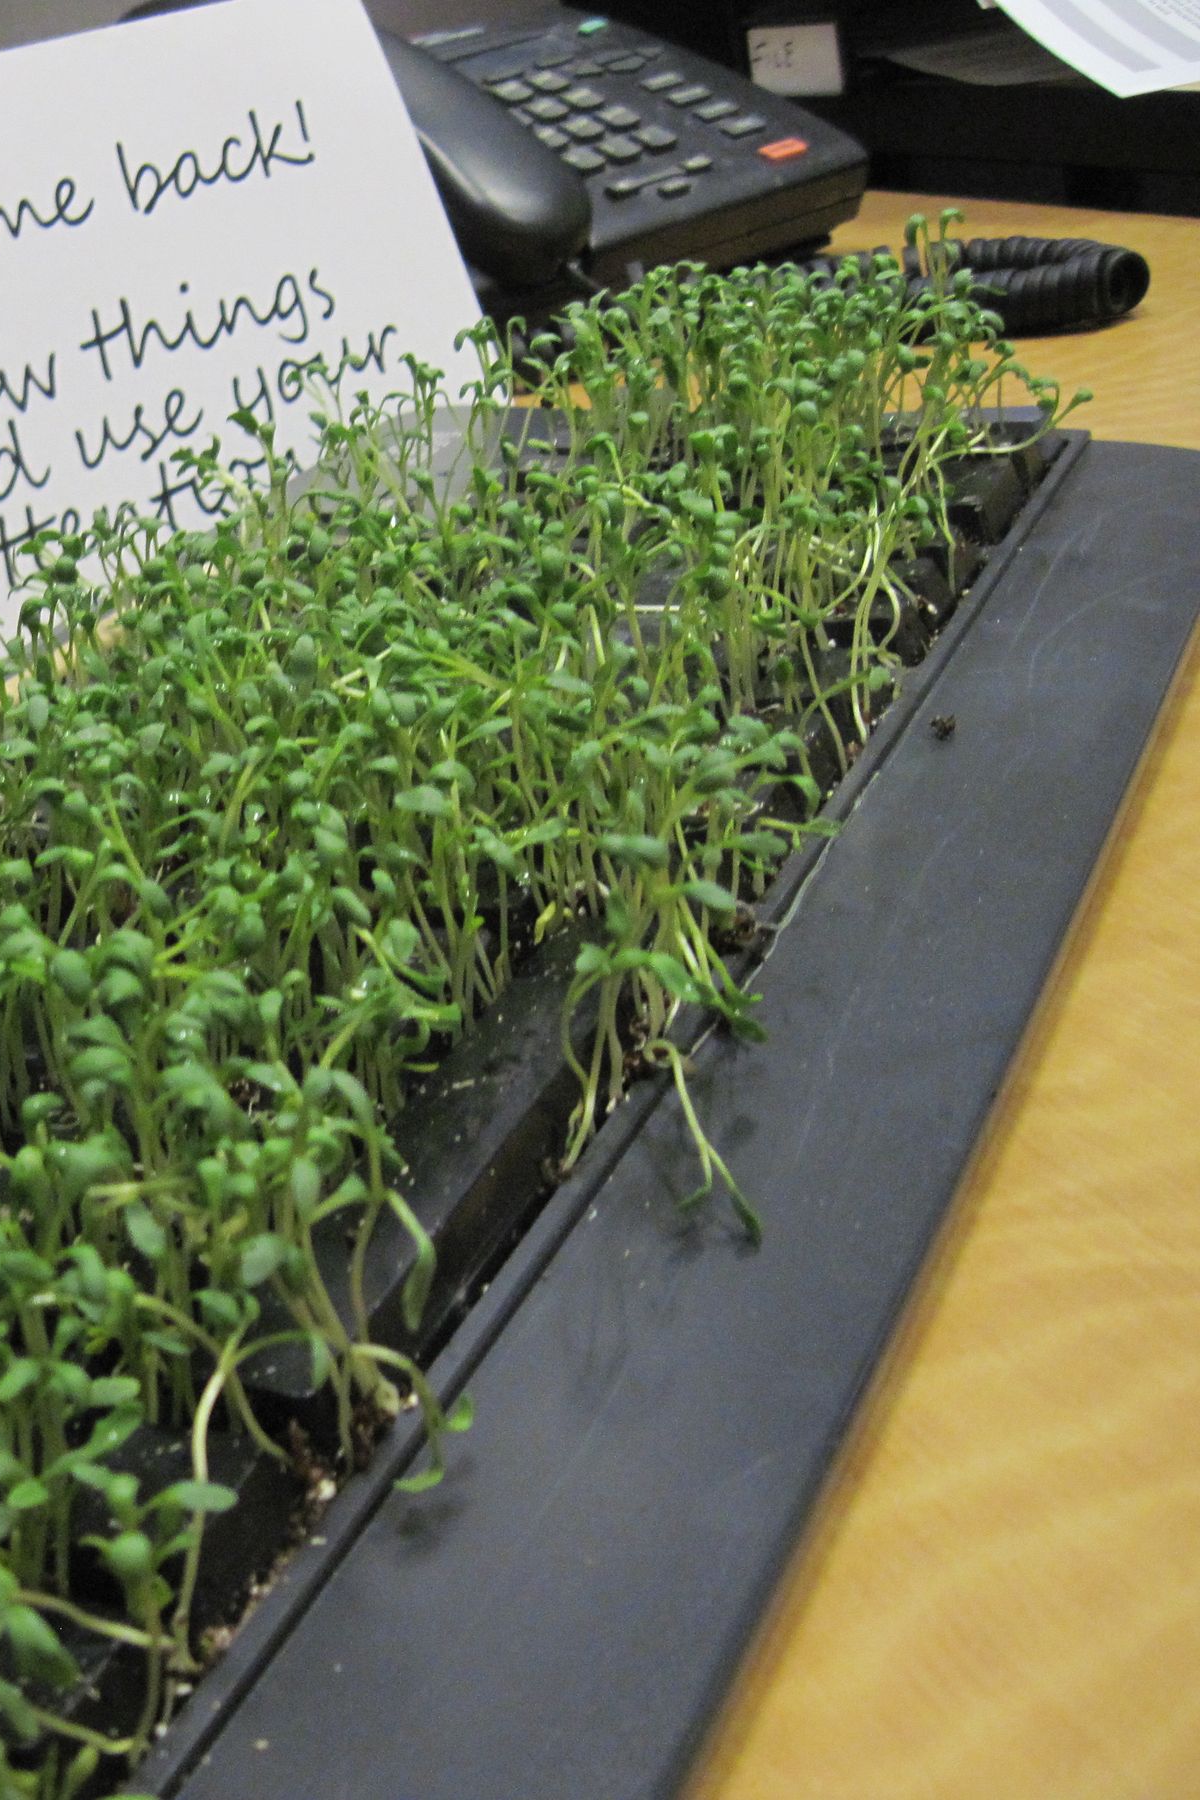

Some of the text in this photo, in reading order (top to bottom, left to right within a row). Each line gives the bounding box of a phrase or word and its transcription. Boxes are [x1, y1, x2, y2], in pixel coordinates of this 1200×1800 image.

[116, 101, 314, 214] back!
[80, 268, 335, 381] things
[75, 389, 203, 469] use
[232, 324, 398, 424] your
